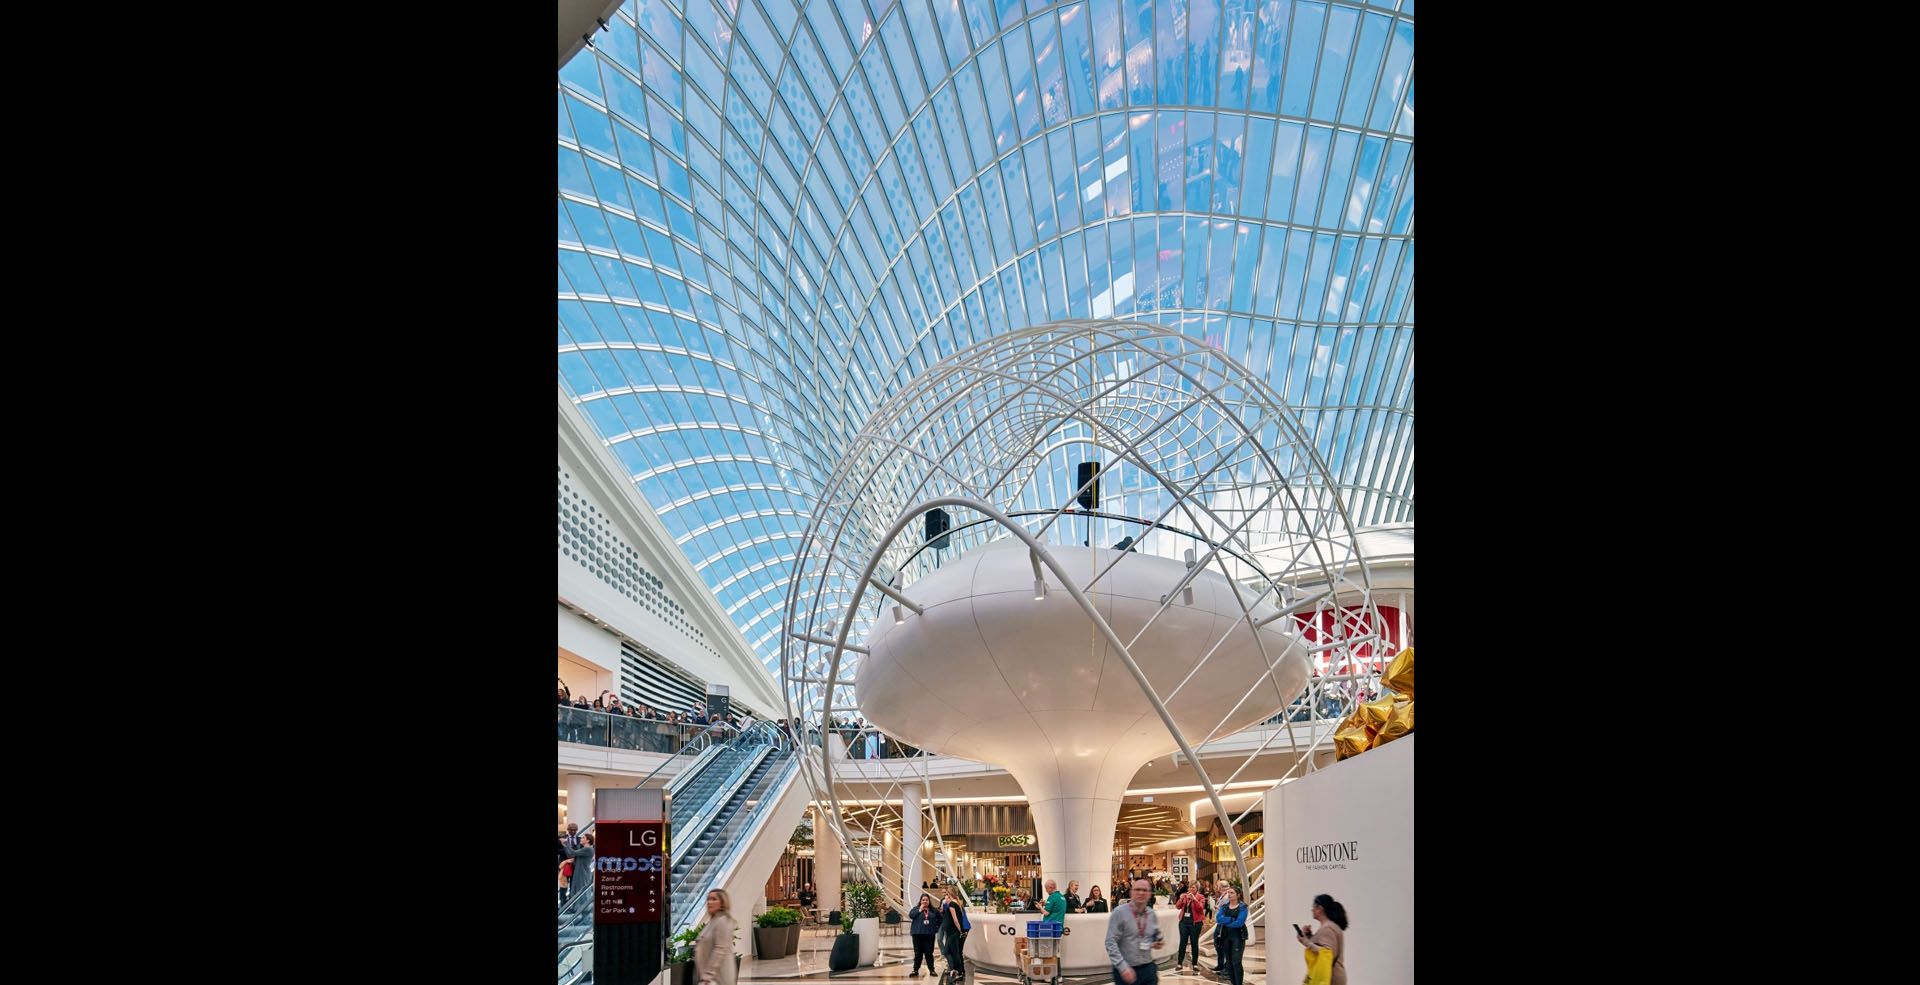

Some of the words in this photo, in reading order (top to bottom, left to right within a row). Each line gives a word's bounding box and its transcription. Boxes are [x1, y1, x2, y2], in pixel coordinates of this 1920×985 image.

[629, 830, 656, 846] LG
[998, 835, 1030, 847] BOOST
[1296, 841, 1358, 863] CHADSTONE
